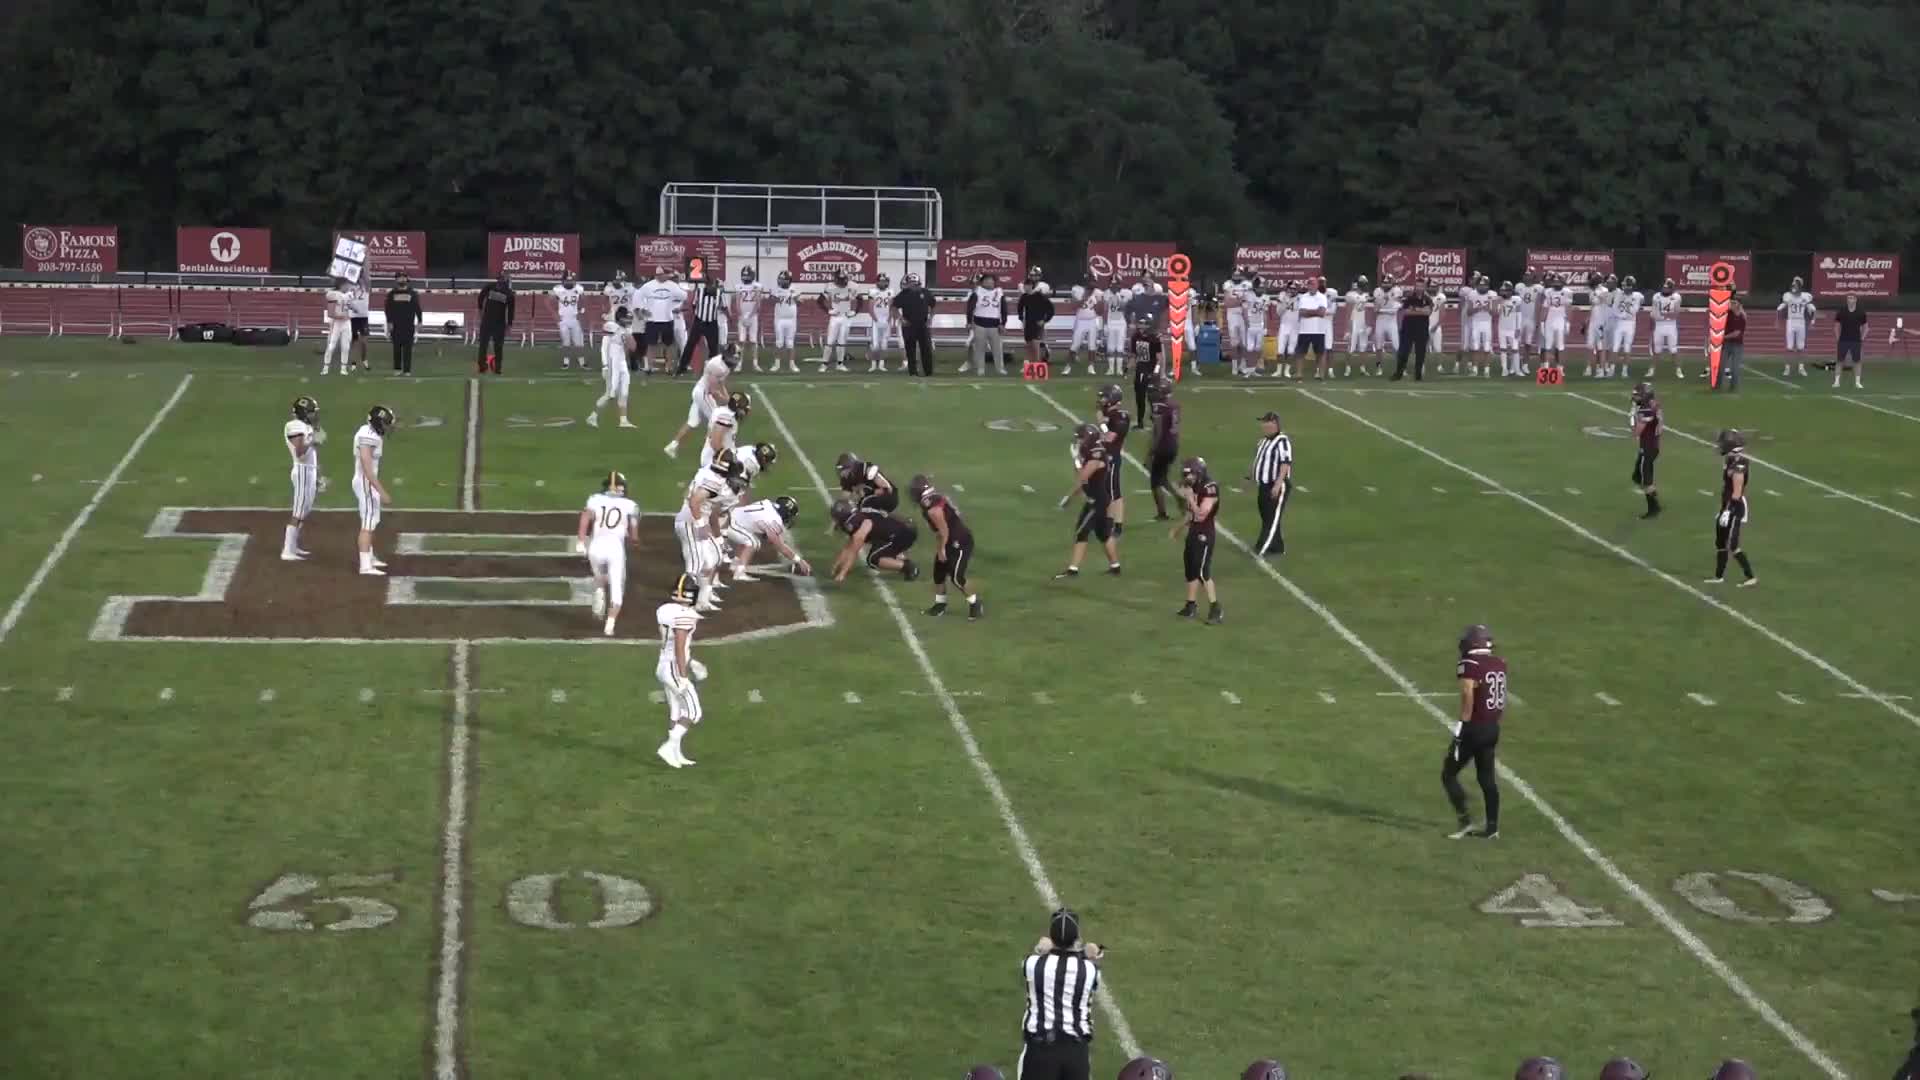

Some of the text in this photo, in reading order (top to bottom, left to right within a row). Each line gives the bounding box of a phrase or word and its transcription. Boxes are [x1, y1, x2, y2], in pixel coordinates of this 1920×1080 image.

[60, 231, 116, 247] FAMOUS
[503, 237, 564, 254] ADDESSI
[60, 246, 100, 259] PIZZA
[1284, 248, 1300, 259] Co.
[1303, 248, 1321, 259] Inc.
[1419, 251, 1461, 264] Capri's
[690, 258, 703, 279] 2
[945, 256, 1016, 268] INGERSOLL
[1415, 263, 1463, 275] Pizzeria
[1025, 365, 1046, 378] 40
[1539, 370, 1558, 384] 30
[600, 505, 622, 530] 10
